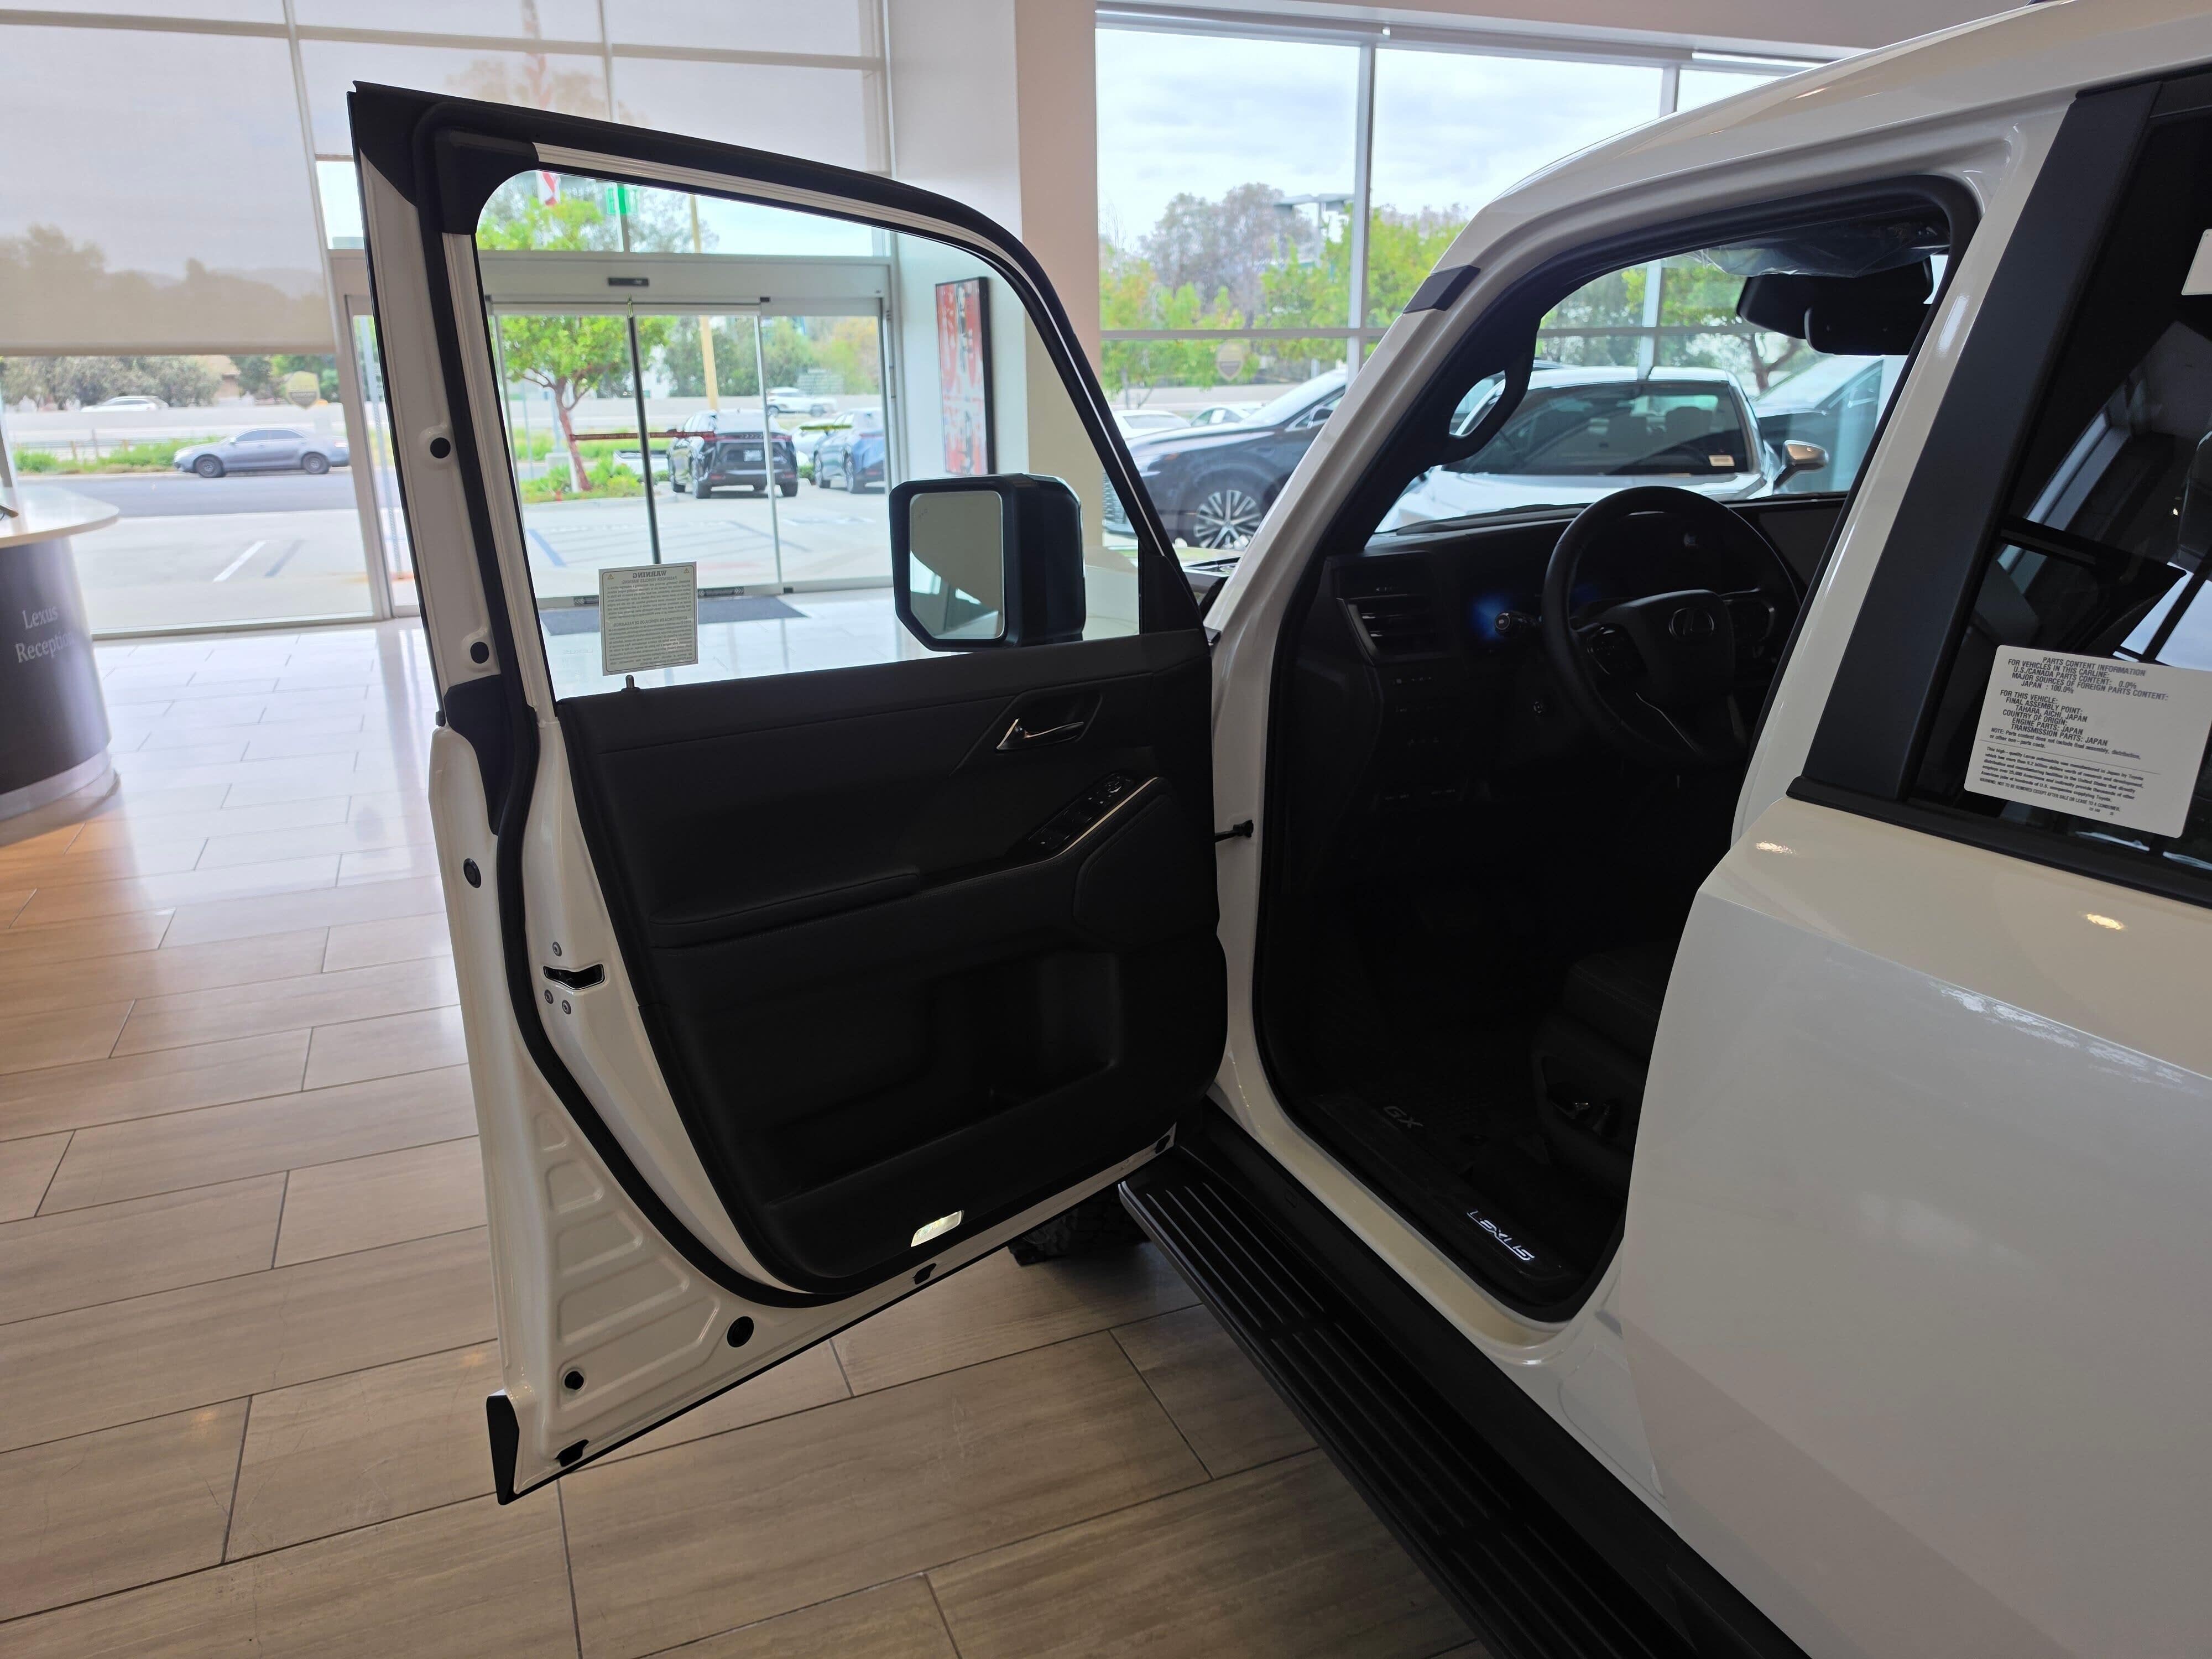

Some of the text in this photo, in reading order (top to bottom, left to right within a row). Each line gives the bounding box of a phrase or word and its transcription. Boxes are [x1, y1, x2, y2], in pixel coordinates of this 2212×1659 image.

[606, 187, 639, 215] EIT
[22, 607, 58, 629] Lexus
[15, 631, 75, 663] Reception
[2022, 661, 2051, 670] VEHICLES
[2063, 666, 2077, 674] THIS
[2079, 669, 2110, 679] CARLINE:
[2043, 657, 2146, 676] PARTS CONTENT INFORMATION
[2013, 666, 2053, 677] U.S./CANADA
[2079, 676, 2112, 685] CONTENT:
[2119, 681, 2136, 689] 0.0%
[2036, 677, 2064, 685] SOURCES
[2077, 682, 2106, 691] FOREIGN
[2108, 686, 2130, 695] PARTS
[2132, 690, 2168, 701] CONTENT:
[2051, 685, 2074, 693] 100.0%
[2025, 700, 2059, 711] ASSEMBLY
[2061, 706, 2083, 714] POINT:
[2031, 695, 2058, 704] VEHICLE:
[2003, 709, 2032, 719] COUNTRY
[2043, 716, 2068, 726] ORIGIN:
[2016, 705, 2041, 714] TAHARA,
[2065, 713, 2088, 722] JAPAN
[2011, 724, 2108, 746] TRANSMISSION PARTS: JAPAN
[2012, 718, 2083, 735] ENGINE PARTS: JAPAN
[1384, 1106, 1423, 1128] GX
[1467, 1209, 1535, 1261] LEXUS
